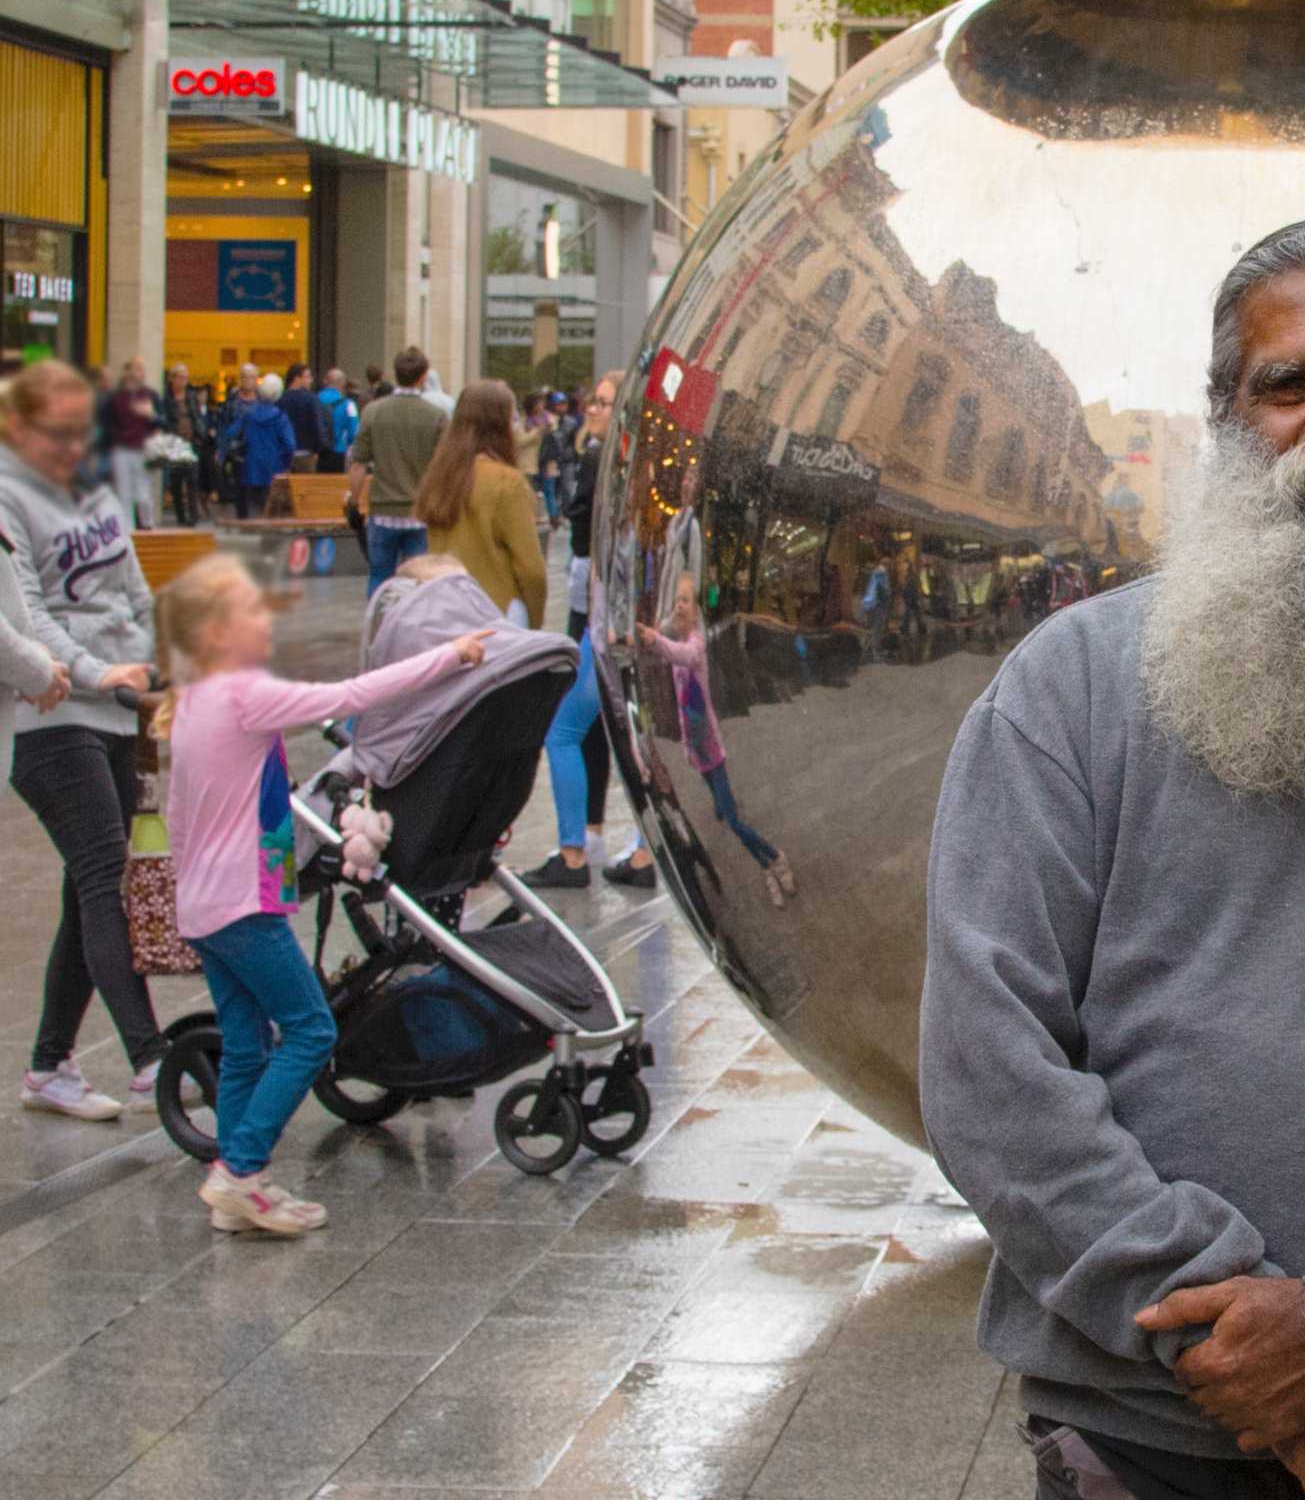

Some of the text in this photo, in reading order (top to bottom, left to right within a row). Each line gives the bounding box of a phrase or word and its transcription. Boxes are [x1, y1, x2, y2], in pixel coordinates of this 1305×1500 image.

[171, 61, 277, 98] coles
[664, 75, 777, 89] RGER DAVID
[14, 271, 35, 299] TED
